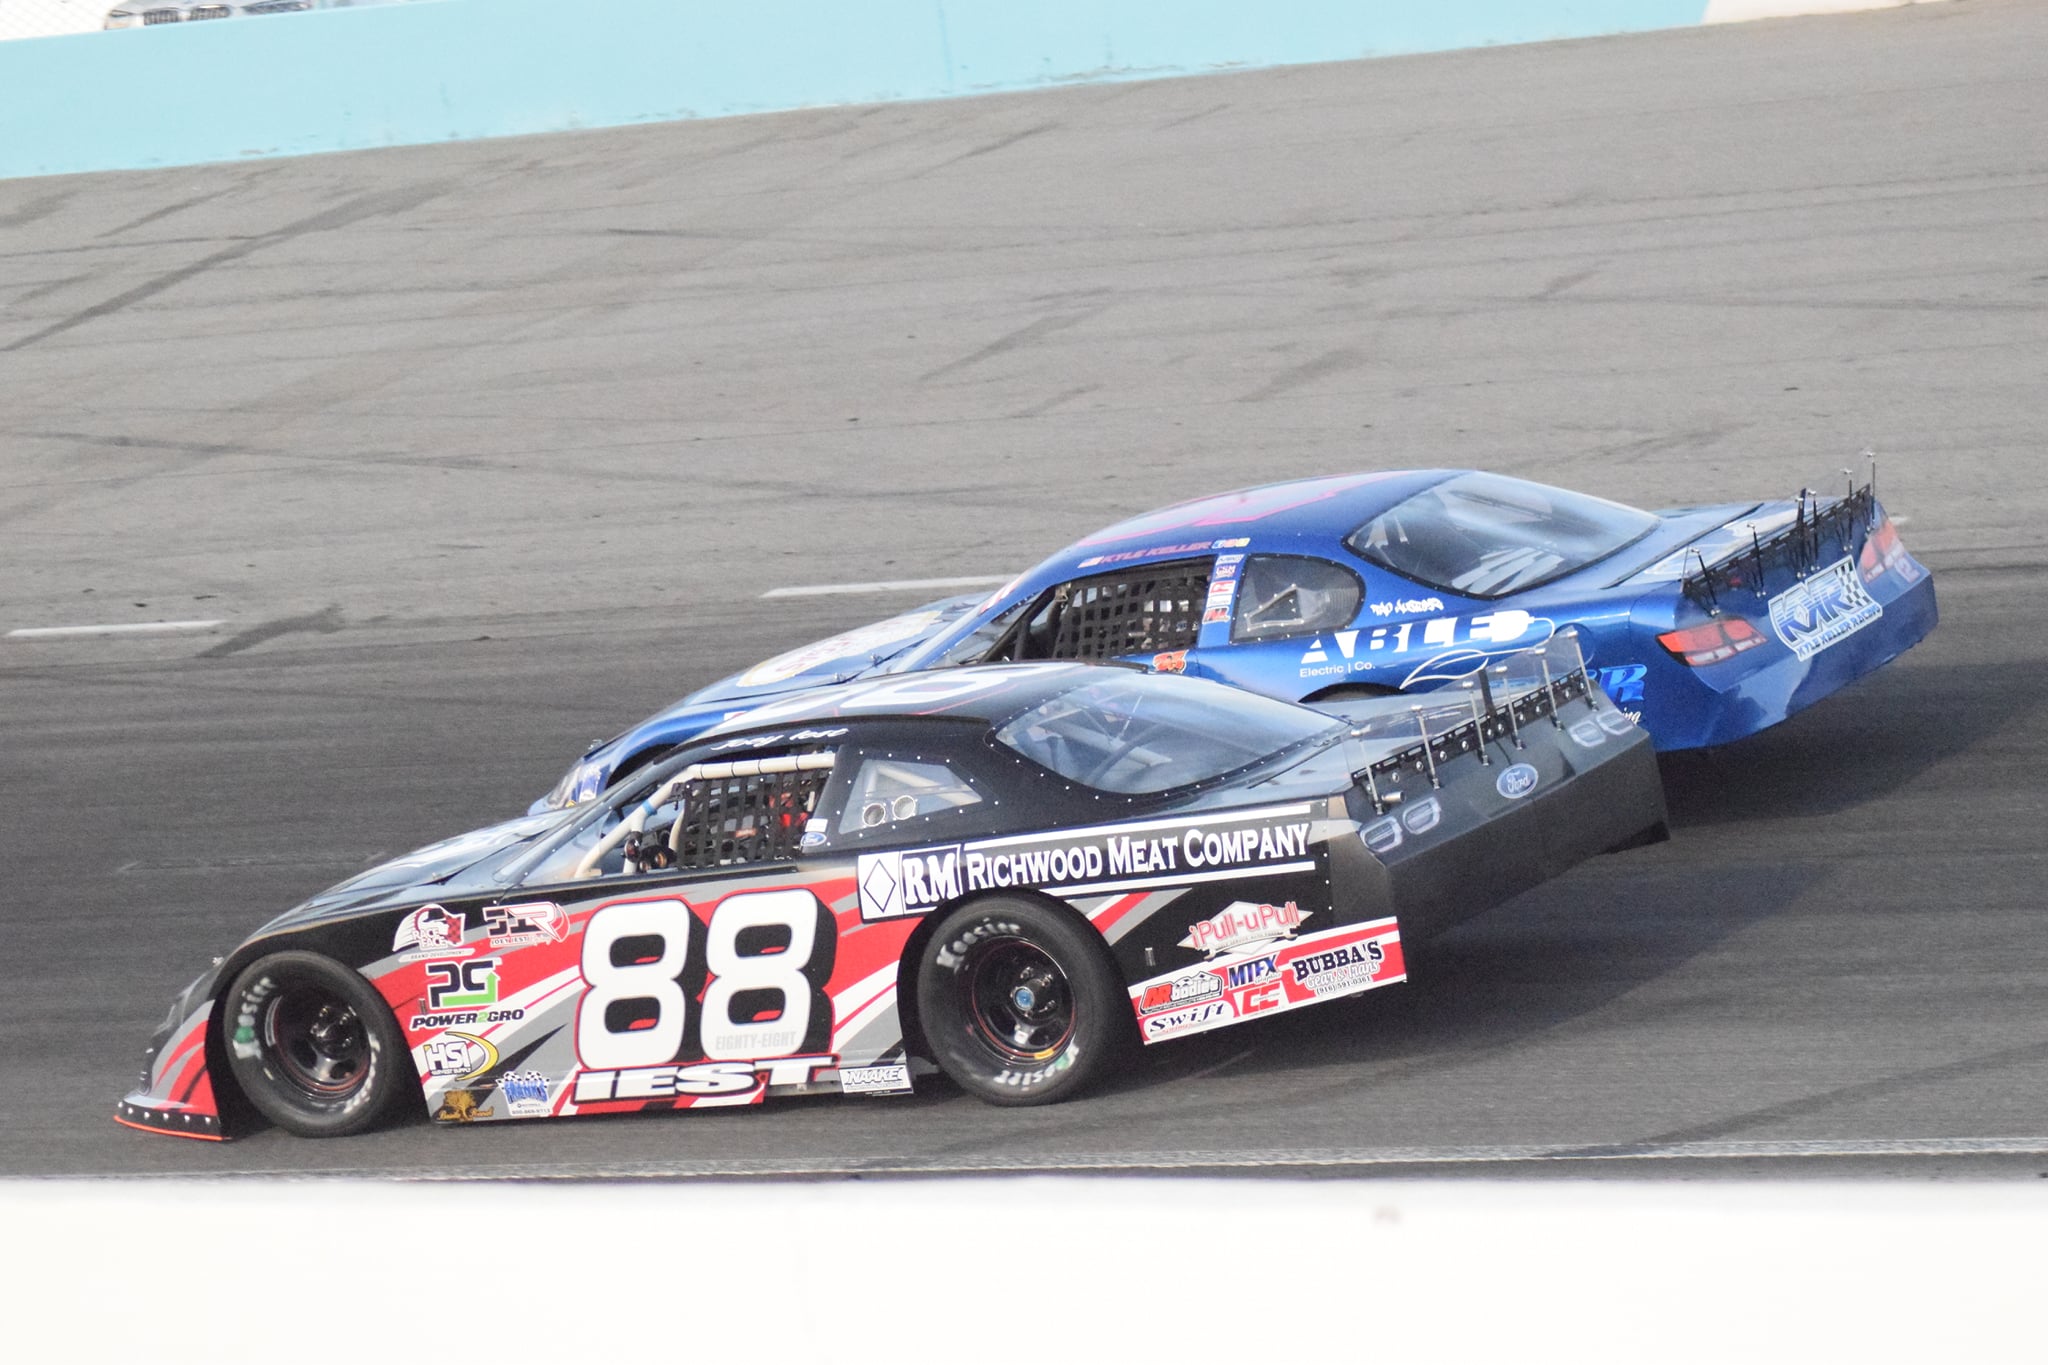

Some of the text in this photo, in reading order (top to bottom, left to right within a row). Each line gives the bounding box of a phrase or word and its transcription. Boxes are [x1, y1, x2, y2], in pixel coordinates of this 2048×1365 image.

[1299, 660, 1376, 679] Electric Co.
[1505, 770, 1533, 793] Ford
[965, 823, 1312, 890] RICHWOOD MEAT COMPANY
[904, 852, 958, 905] RM
[1292, 940, 1383, 982] BUBBA'S
[1305, 973, 1334, 989] Gear
[1349, 961, 1379, 978] Trans
[577, 888, 818, 1070] 88
[411, 1009, 525, 1029] POWER2GRO
[1150, 1003, 1225, 1033] Swift
[423, 1041, 472, 1070] HSI
[715, 1031, 798, 1051] EIGHTY-EIGHT
[573, 1056, 833, 1101] IEST
[845, 1067, 904, 1085] NAAKE
